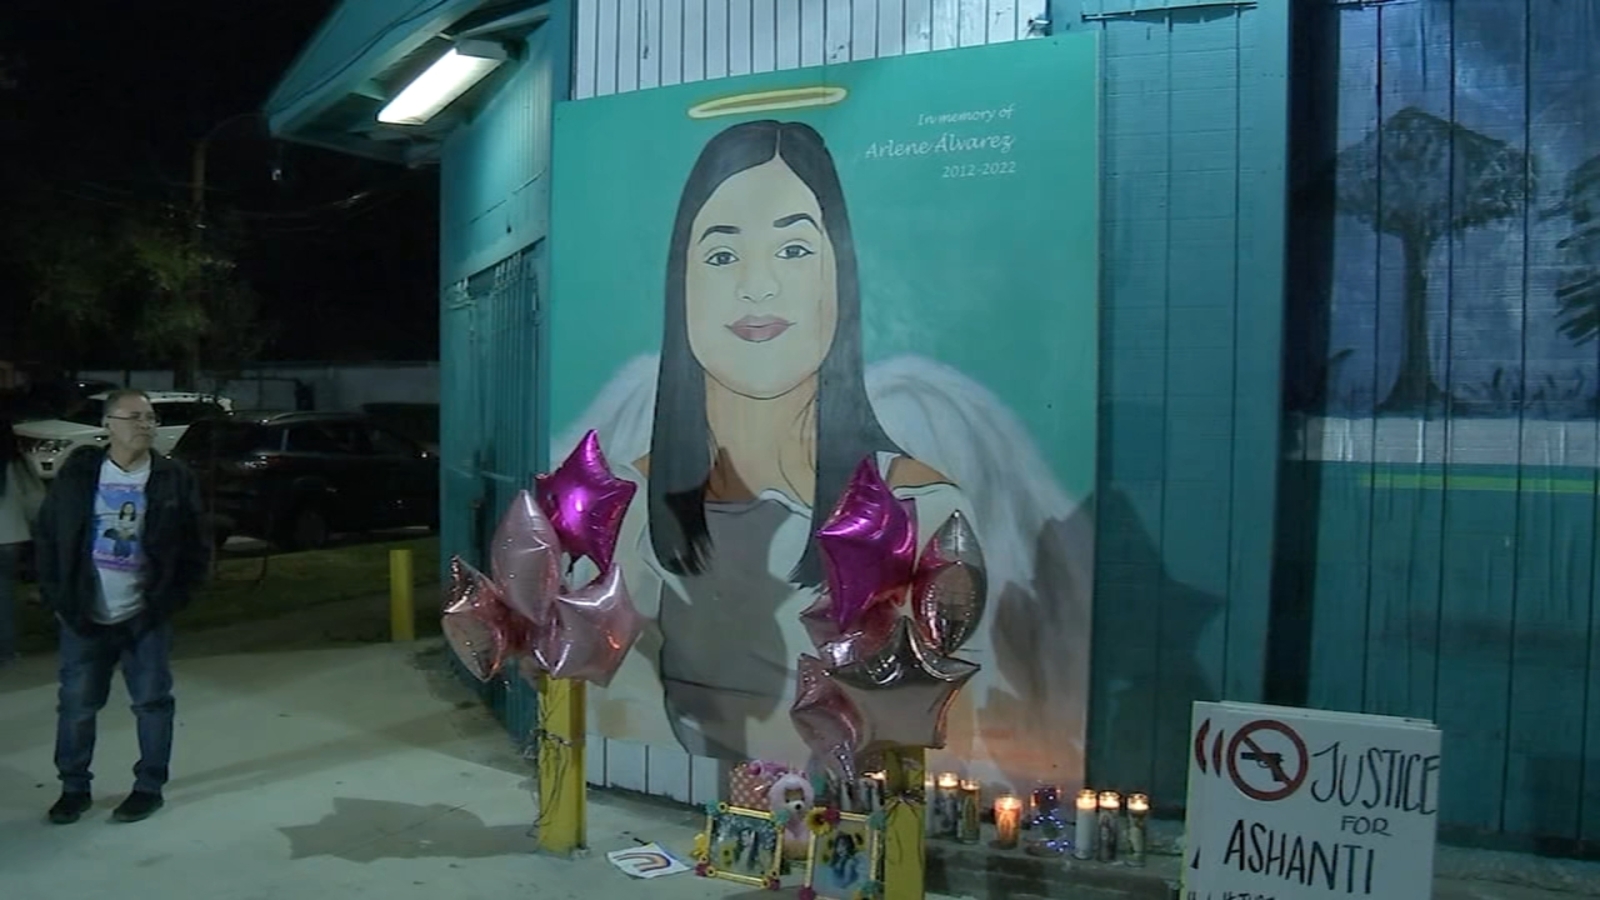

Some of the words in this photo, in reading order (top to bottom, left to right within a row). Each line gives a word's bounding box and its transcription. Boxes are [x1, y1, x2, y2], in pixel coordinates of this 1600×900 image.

[918, 113, 937, 126] In
[939, 110, 997, 123] memory
[998, 103, 1015, 119] of
[865, 139, 931, 158] Arlene
[934, 131, 1015, 154] Álvarez
[942, 161, 1016, 178] 2012-2022
[1310, 741, 1440, 815] JUSTICE
[1341, 815, 1393, 836] FOR
[1223, 819, 1375, 895] ASHANTI
